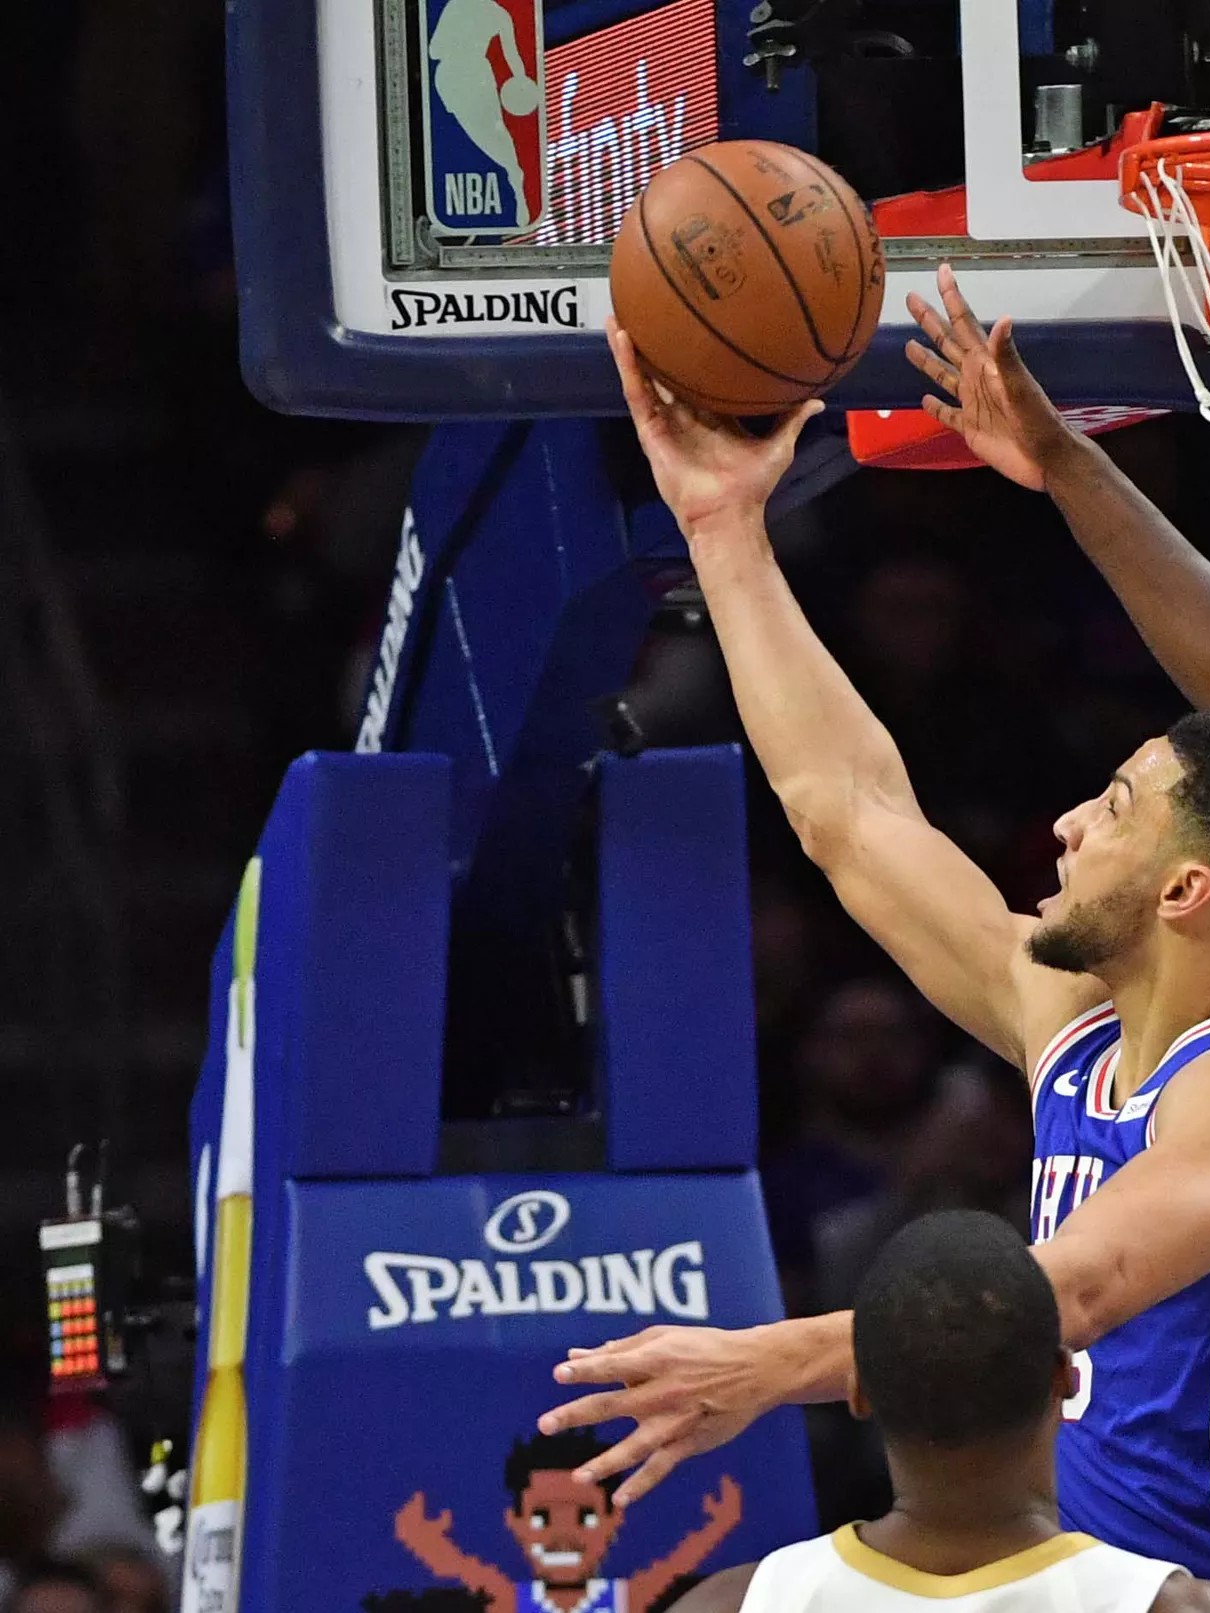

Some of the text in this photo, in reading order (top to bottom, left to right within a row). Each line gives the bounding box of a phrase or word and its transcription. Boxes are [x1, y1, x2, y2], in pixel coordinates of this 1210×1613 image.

[446, 172, 502, 215] NBA
[391, 286, 578, 330] SPALDING
[365, 1241, 710, 1330] SPALDING
